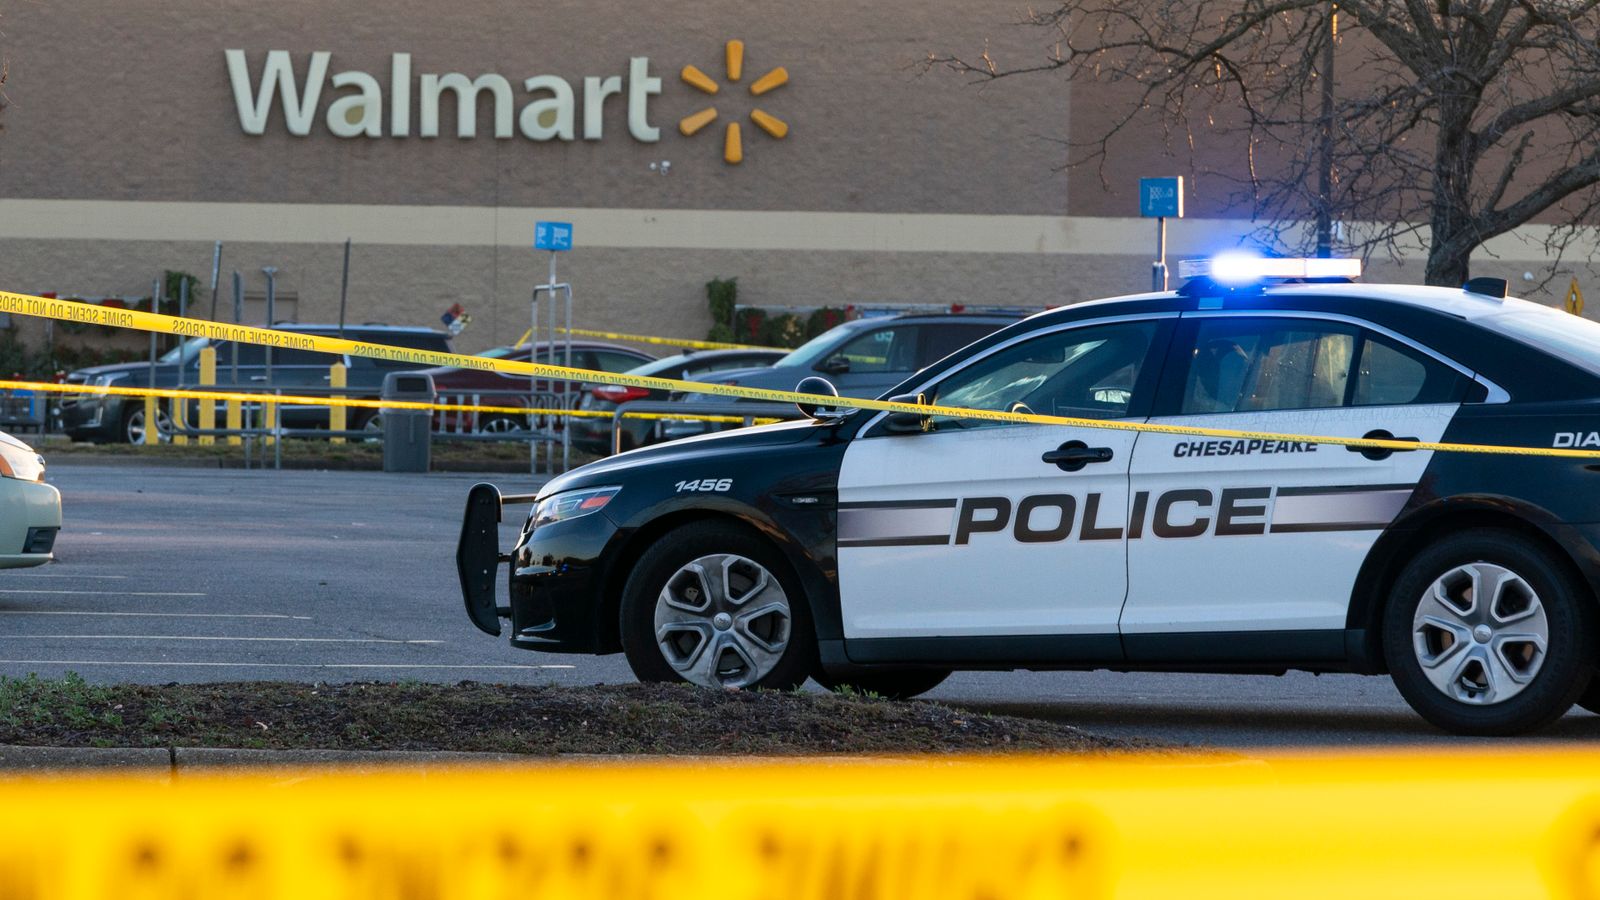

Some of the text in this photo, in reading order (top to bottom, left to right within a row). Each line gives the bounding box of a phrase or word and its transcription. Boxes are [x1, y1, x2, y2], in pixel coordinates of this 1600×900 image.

[223, 48, 662, 142] Walmart
[1174, 440, 1318, 458] CHESAPEAKE
[674, 478, 734, 493] 1456
[954, 486, 1272, 546] POLICE
